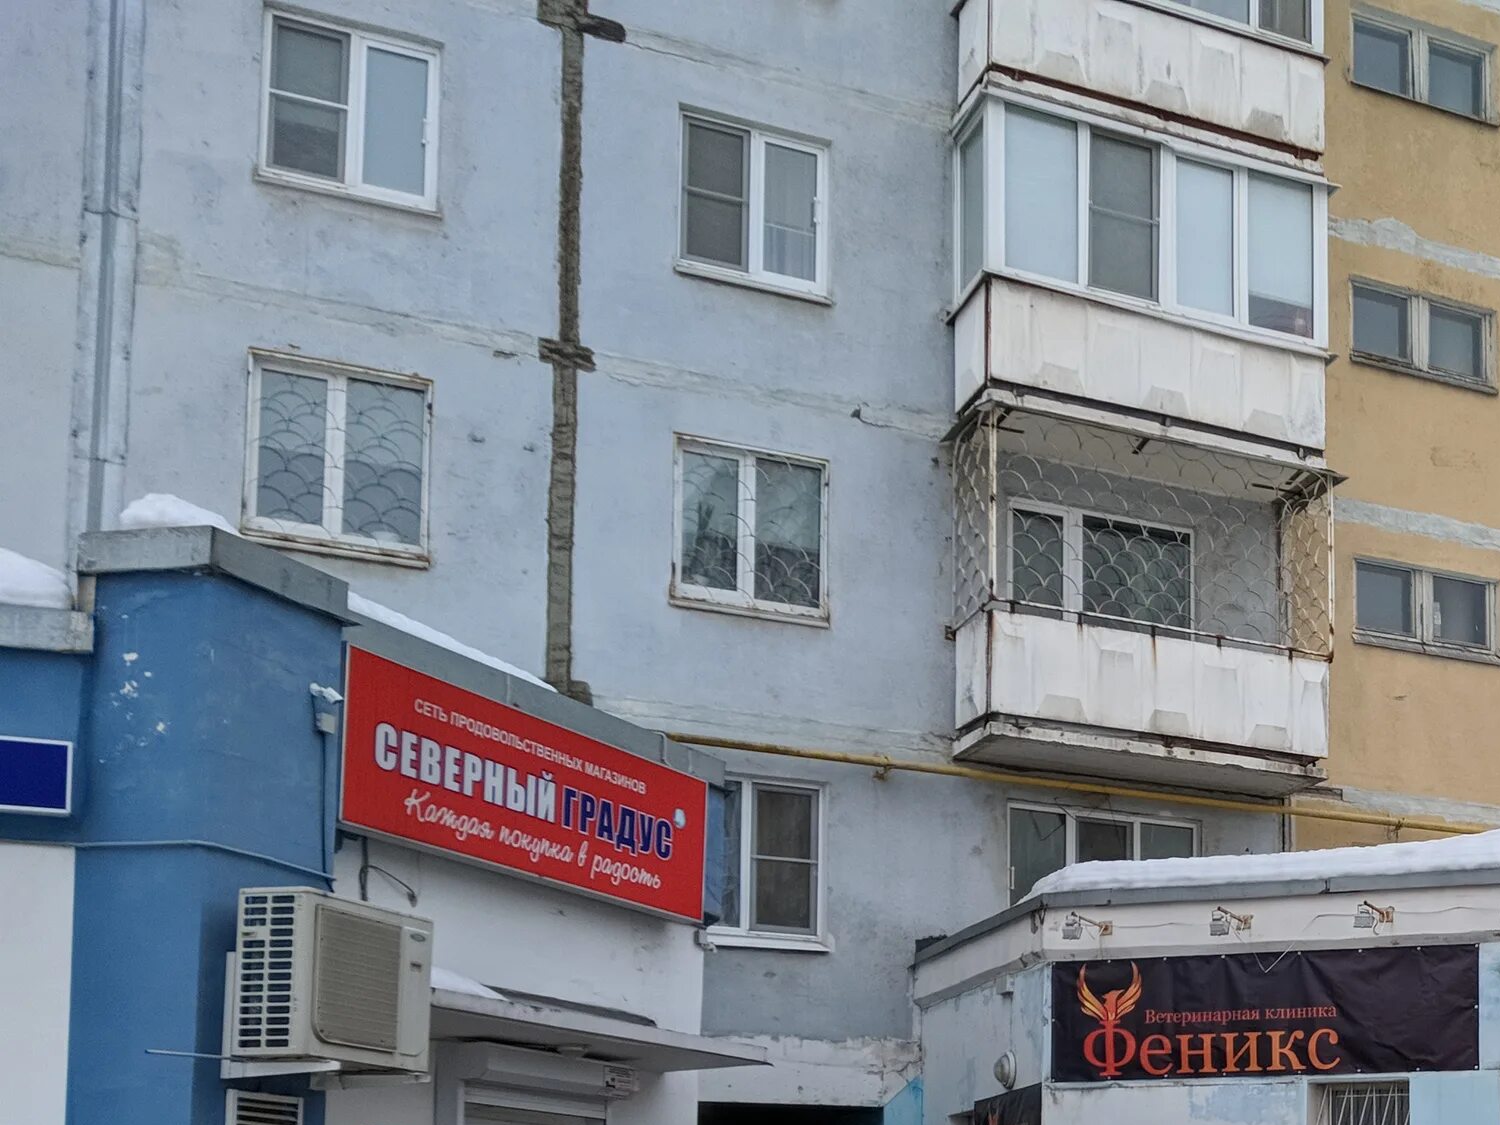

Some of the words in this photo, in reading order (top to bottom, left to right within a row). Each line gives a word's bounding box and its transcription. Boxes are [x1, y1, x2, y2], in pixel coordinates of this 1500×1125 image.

[374, 722, 556, 824] СЕВЕРНЫЙ
[562, 785, 674, 861] ГРАДУС
[414, 699, 448, 722] СЕТЬ
[450, 711, 584, 772] ПРОДОВОЛЬСТВЕННЫХ
[585, 760, 647, 795] МАГАЗИНОВ
[404, 788, 494, 841] Каждая
[499, 825, 575, 863] покупка
[577, 841, 589, 867] в
[590, 855, 662, 890] радость
[1083, 1020, 1341, 1077] Феникс
[1144, 1008, 1260, 1026] Ветеринарная
[1265, 1005, 1337, 1020] клиника
